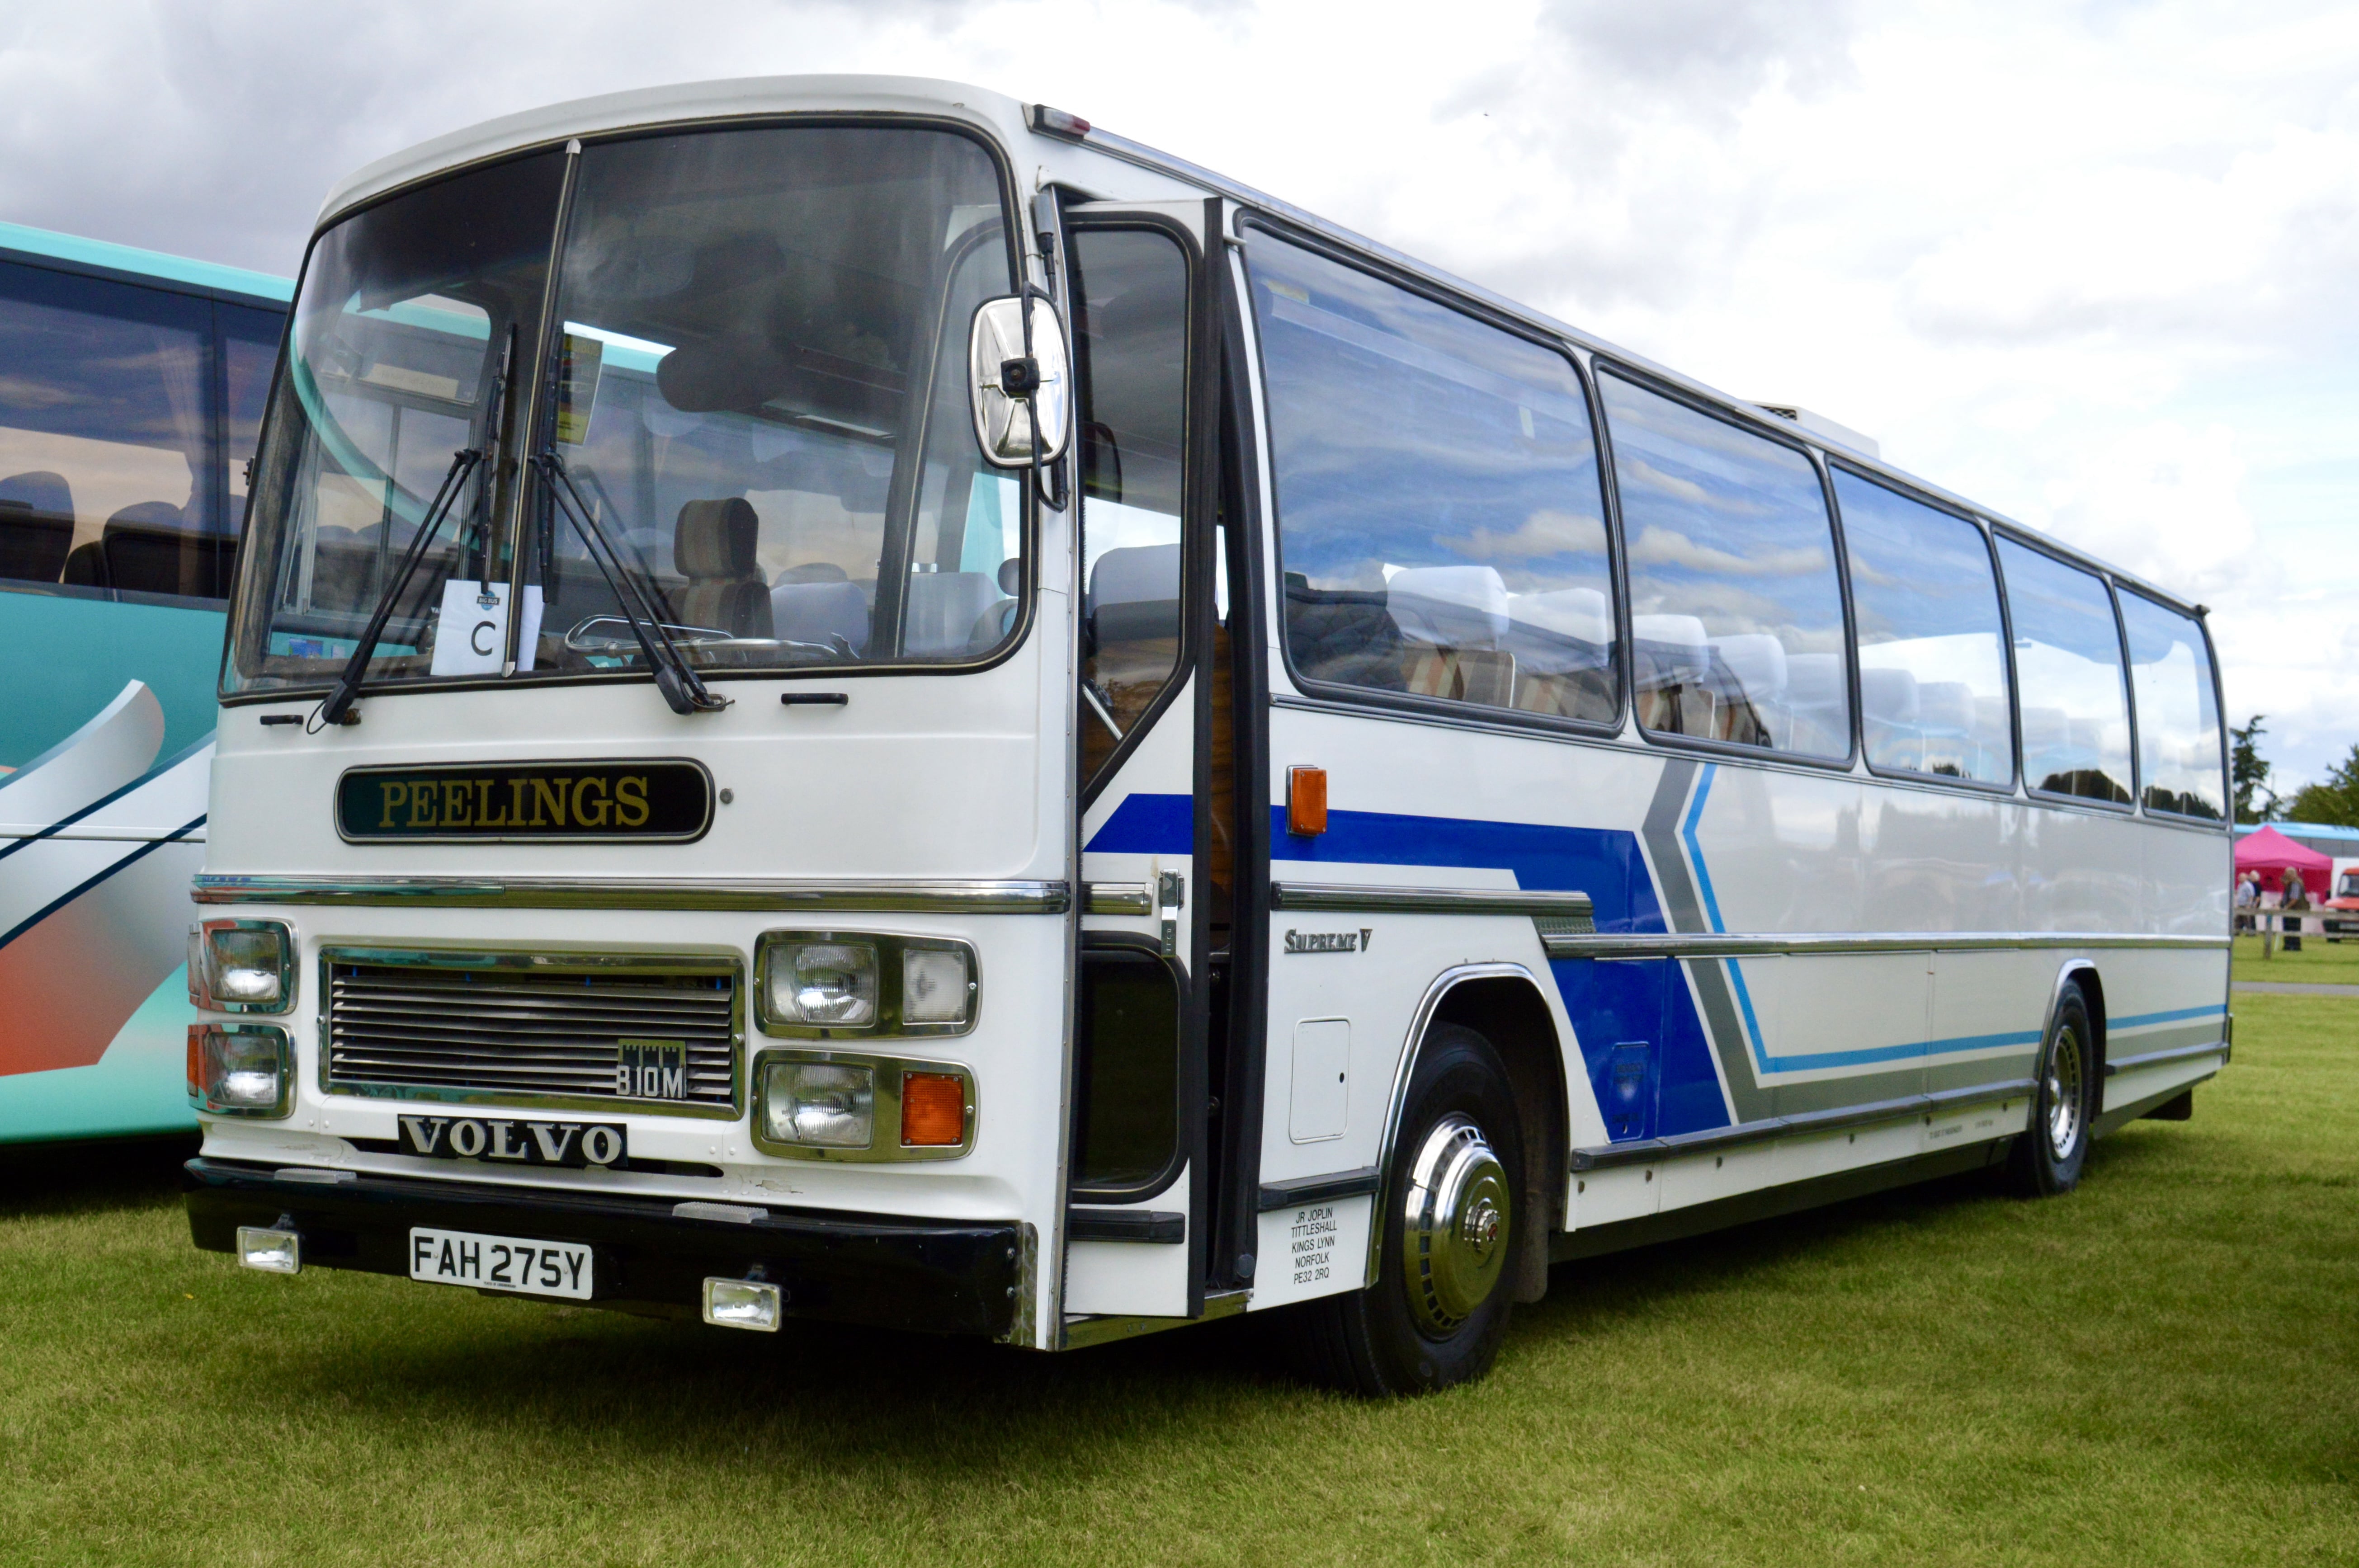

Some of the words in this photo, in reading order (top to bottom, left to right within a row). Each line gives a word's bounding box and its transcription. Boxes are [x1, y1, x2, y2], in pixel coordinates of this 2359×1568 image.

[471, 621, 495, 656] C
[379, 776, 650, 828] PEELINGS
[616, 1065, 683, 1098] B10M
[399, 1116, 623, 1165] VOLVO
[1296, 1211, 1305, 1224] JR
[1308, 1207, 1333, 1221] JOPLIN
[1291, 1220, 1337, 1238] TITTLESHALL
[1292, 1239, 1315, 1253] KINGS
[1317, 1235, 1335, 1249] LYNN
[415, 1236, 480, 1279] FAH
[491, 1244, 585, 1290] 275Y
[1295, 1252, 1330, 1268] NORFOLK
[1294, 1270, 1312, 1284] PE32
[1315, 1267, 1330, 1280] 2RQ
